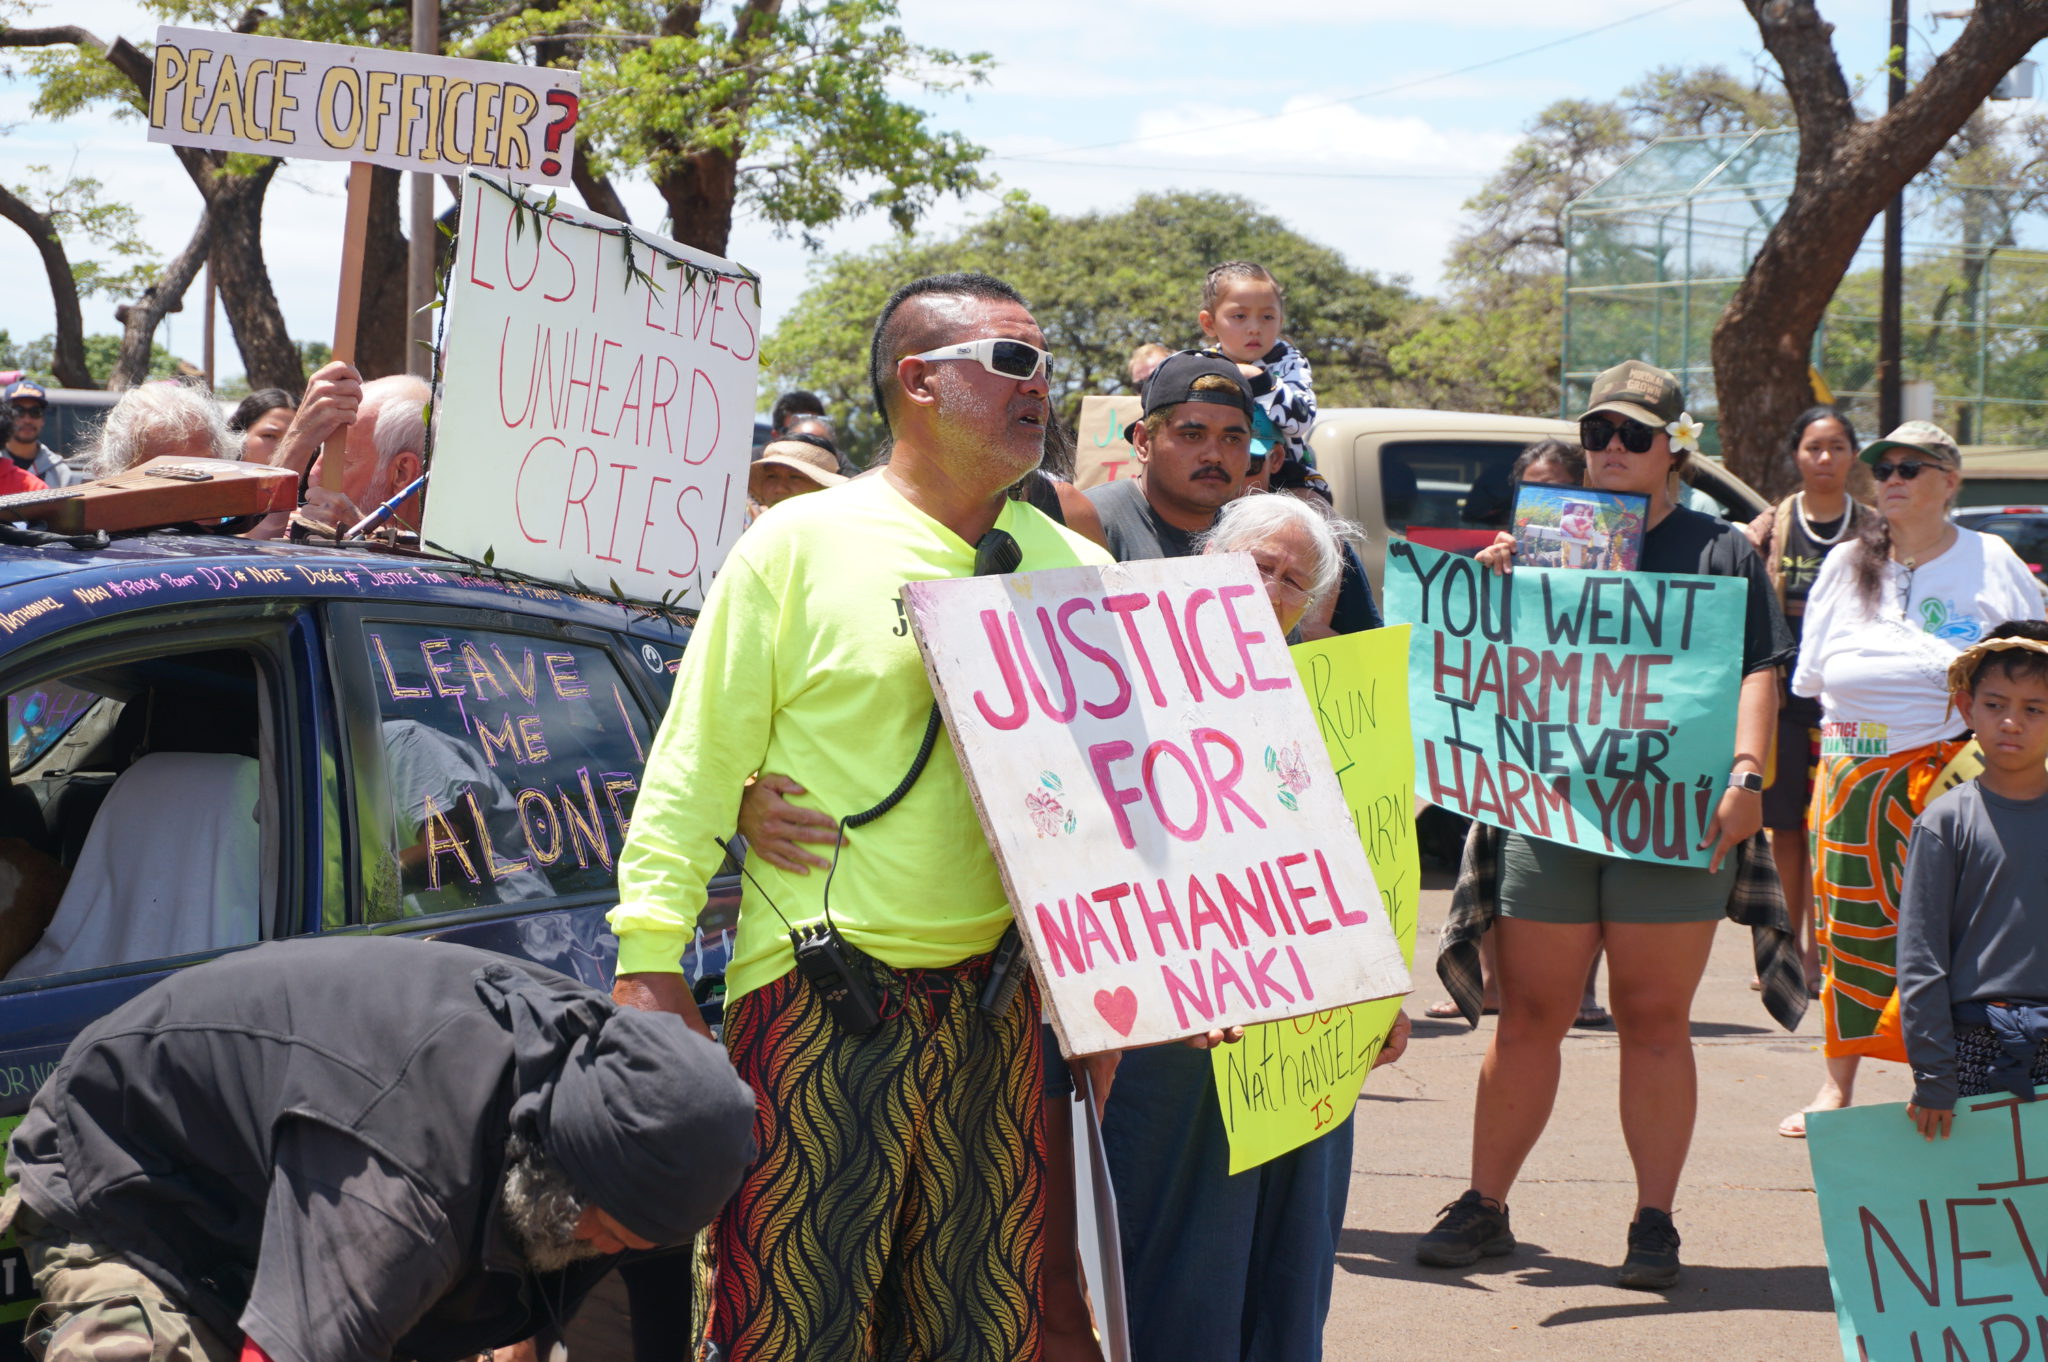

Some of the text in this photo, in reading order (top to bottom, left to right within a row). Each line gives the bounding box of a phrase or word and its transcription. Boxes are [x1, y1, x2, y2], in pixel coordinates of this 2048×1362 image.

[150, 44, 579, 177] PEACE OFFICER?
[470, 186, 756, 362] LOST LIVES
[499, 316, 721, 466] UNHEARD
[515, 437, 732, 579] CRIES!
[0, 596, 65, 634] NATHANIEL
[72, 585, 112, 604] NAKI
[197, 566, 239, 590] DJ
[295, 564, 348, 585] DOGG
[412, 566, 447, 584] FOR
[1540, 573, 1716, 650] WENT
[370, 633, 592, 706] LEAVE
[973, 584, 1292, 731] JUSTICE
[1433, 629, 1583, 724] HARM
[473, 712, 550, 767] ME
[1088, 727, 1268, 850] FOR
[1424, 739, 1579, 844] HARM
[1434, 694, 1671, 784] I NEVER
[424, 766, 638, 891] ALONE
[1035, 849, 1369, 977] NATHANIEL
[1159, 945, 1315, 1030] NAKI
[1310, 1094, 1335, 1131] IS
